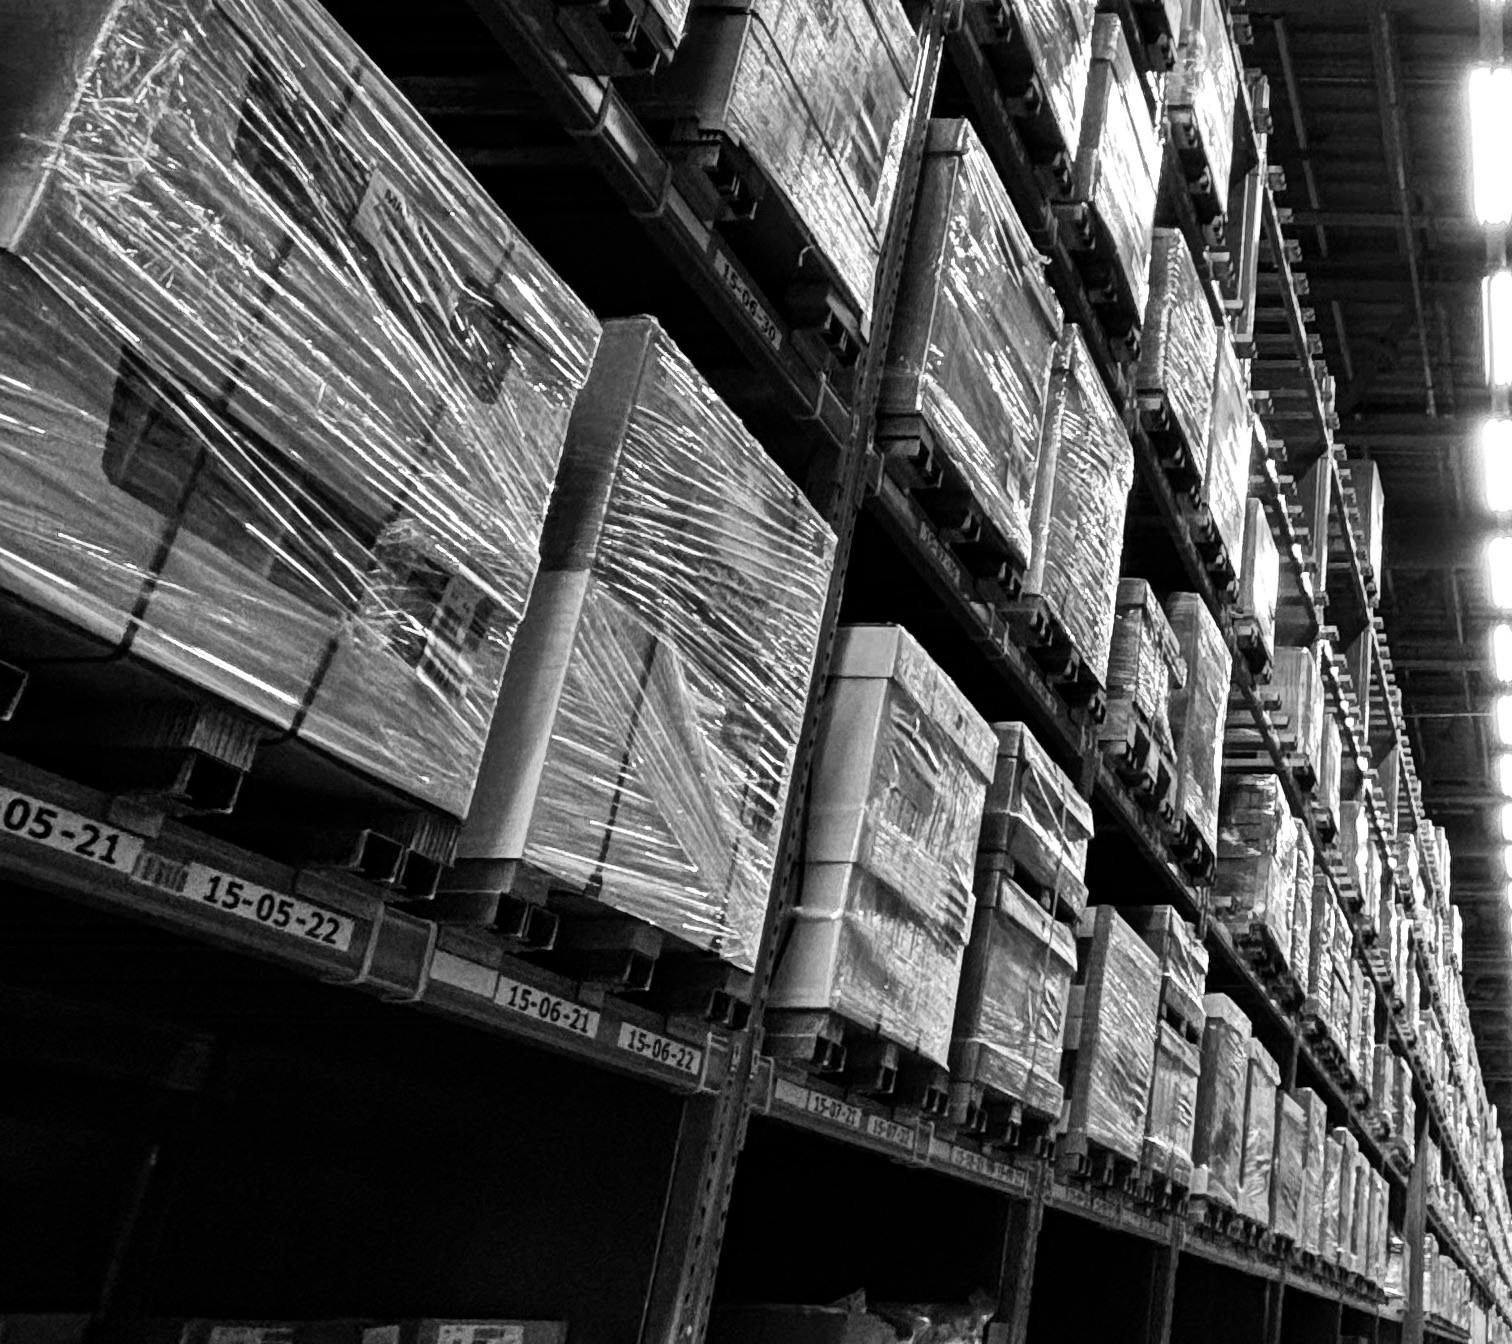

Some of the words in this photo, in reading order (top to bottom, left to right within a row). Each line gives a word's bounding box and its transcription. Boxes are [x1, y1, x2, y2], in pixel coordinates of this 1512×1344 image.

[723, 263, 777, 341] 15-06-30
[202, 874, 342, 945] 15-05-22
[507, 985, 590, 1034] 15-06-21
[627, 1029, 694, 1071] 15-06-22
